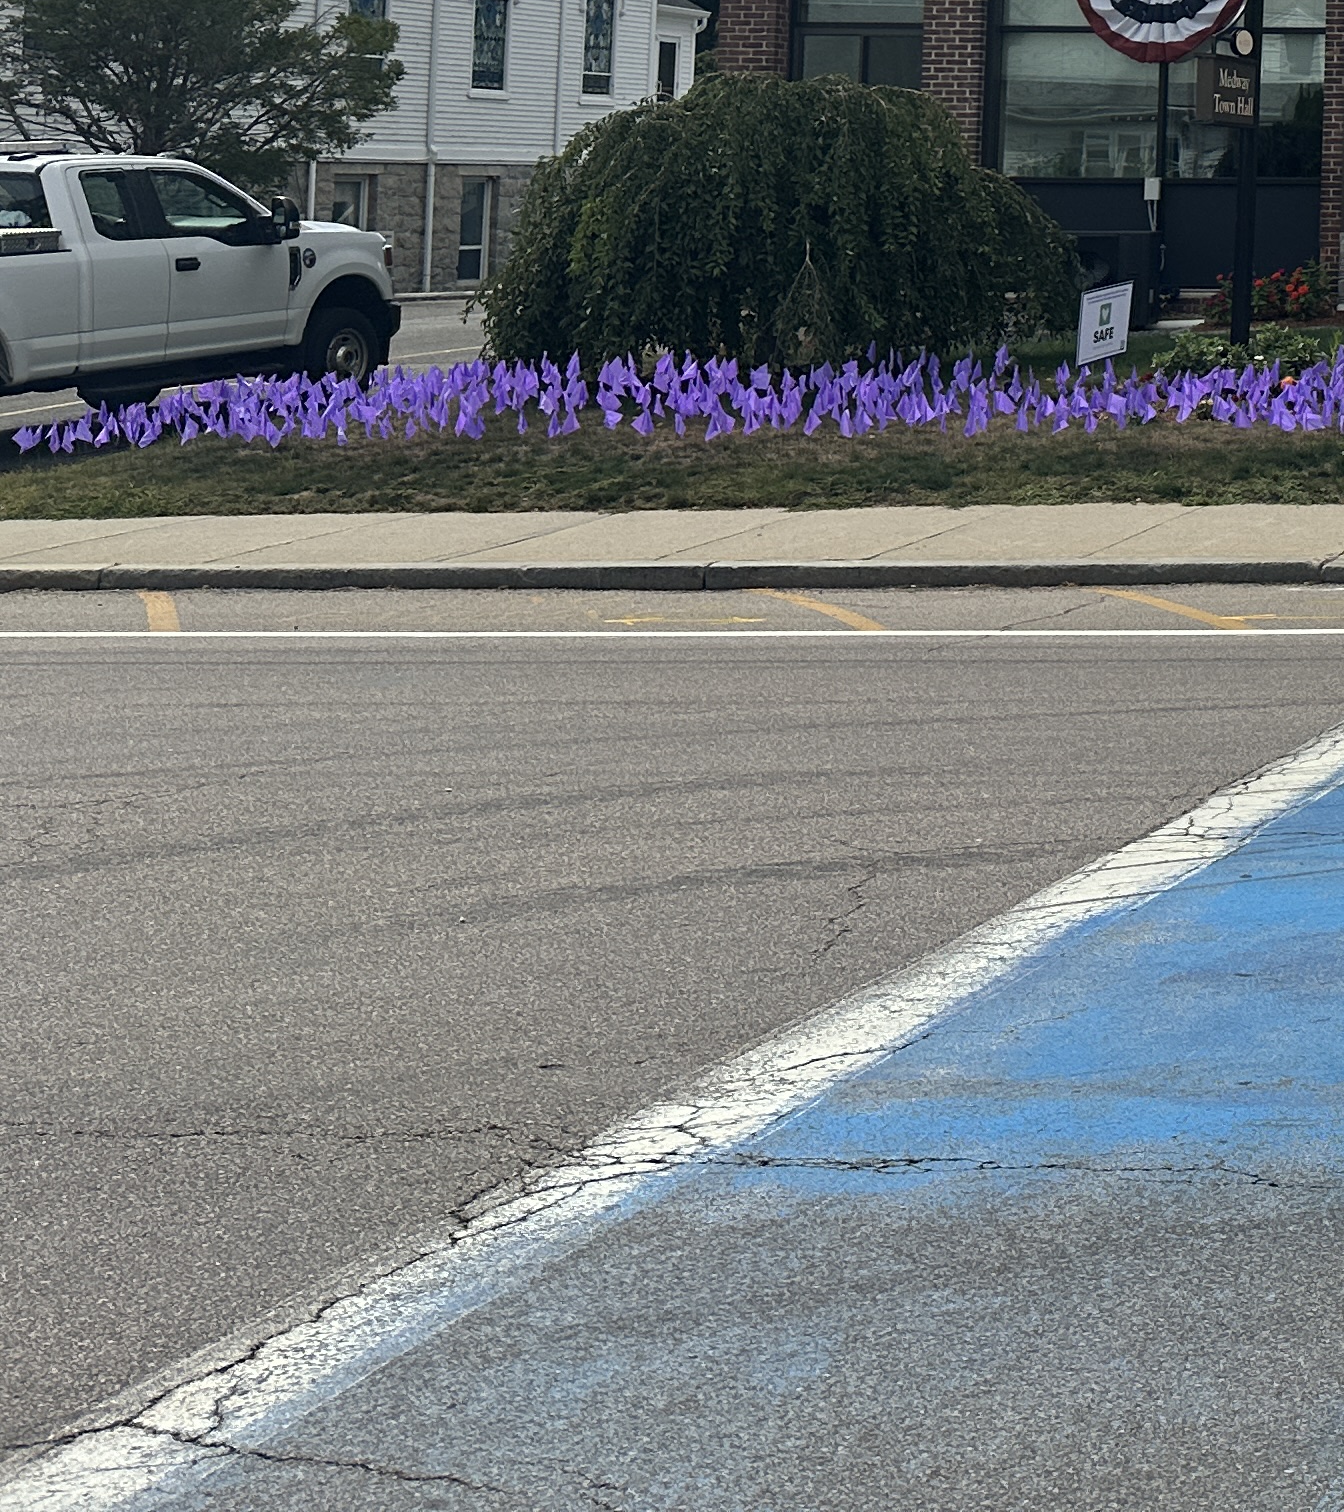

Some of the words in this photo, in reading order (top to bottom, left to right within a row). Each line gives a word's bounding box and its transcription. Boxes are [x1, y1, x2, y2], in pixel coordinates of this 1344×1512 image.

[1219, 68, 1250, 94] Medway
[1214, 94, 1236, 114] Town
[1237, 96, 1254, 116] Hall
[1093, 326, 1114, 343] SAFE
